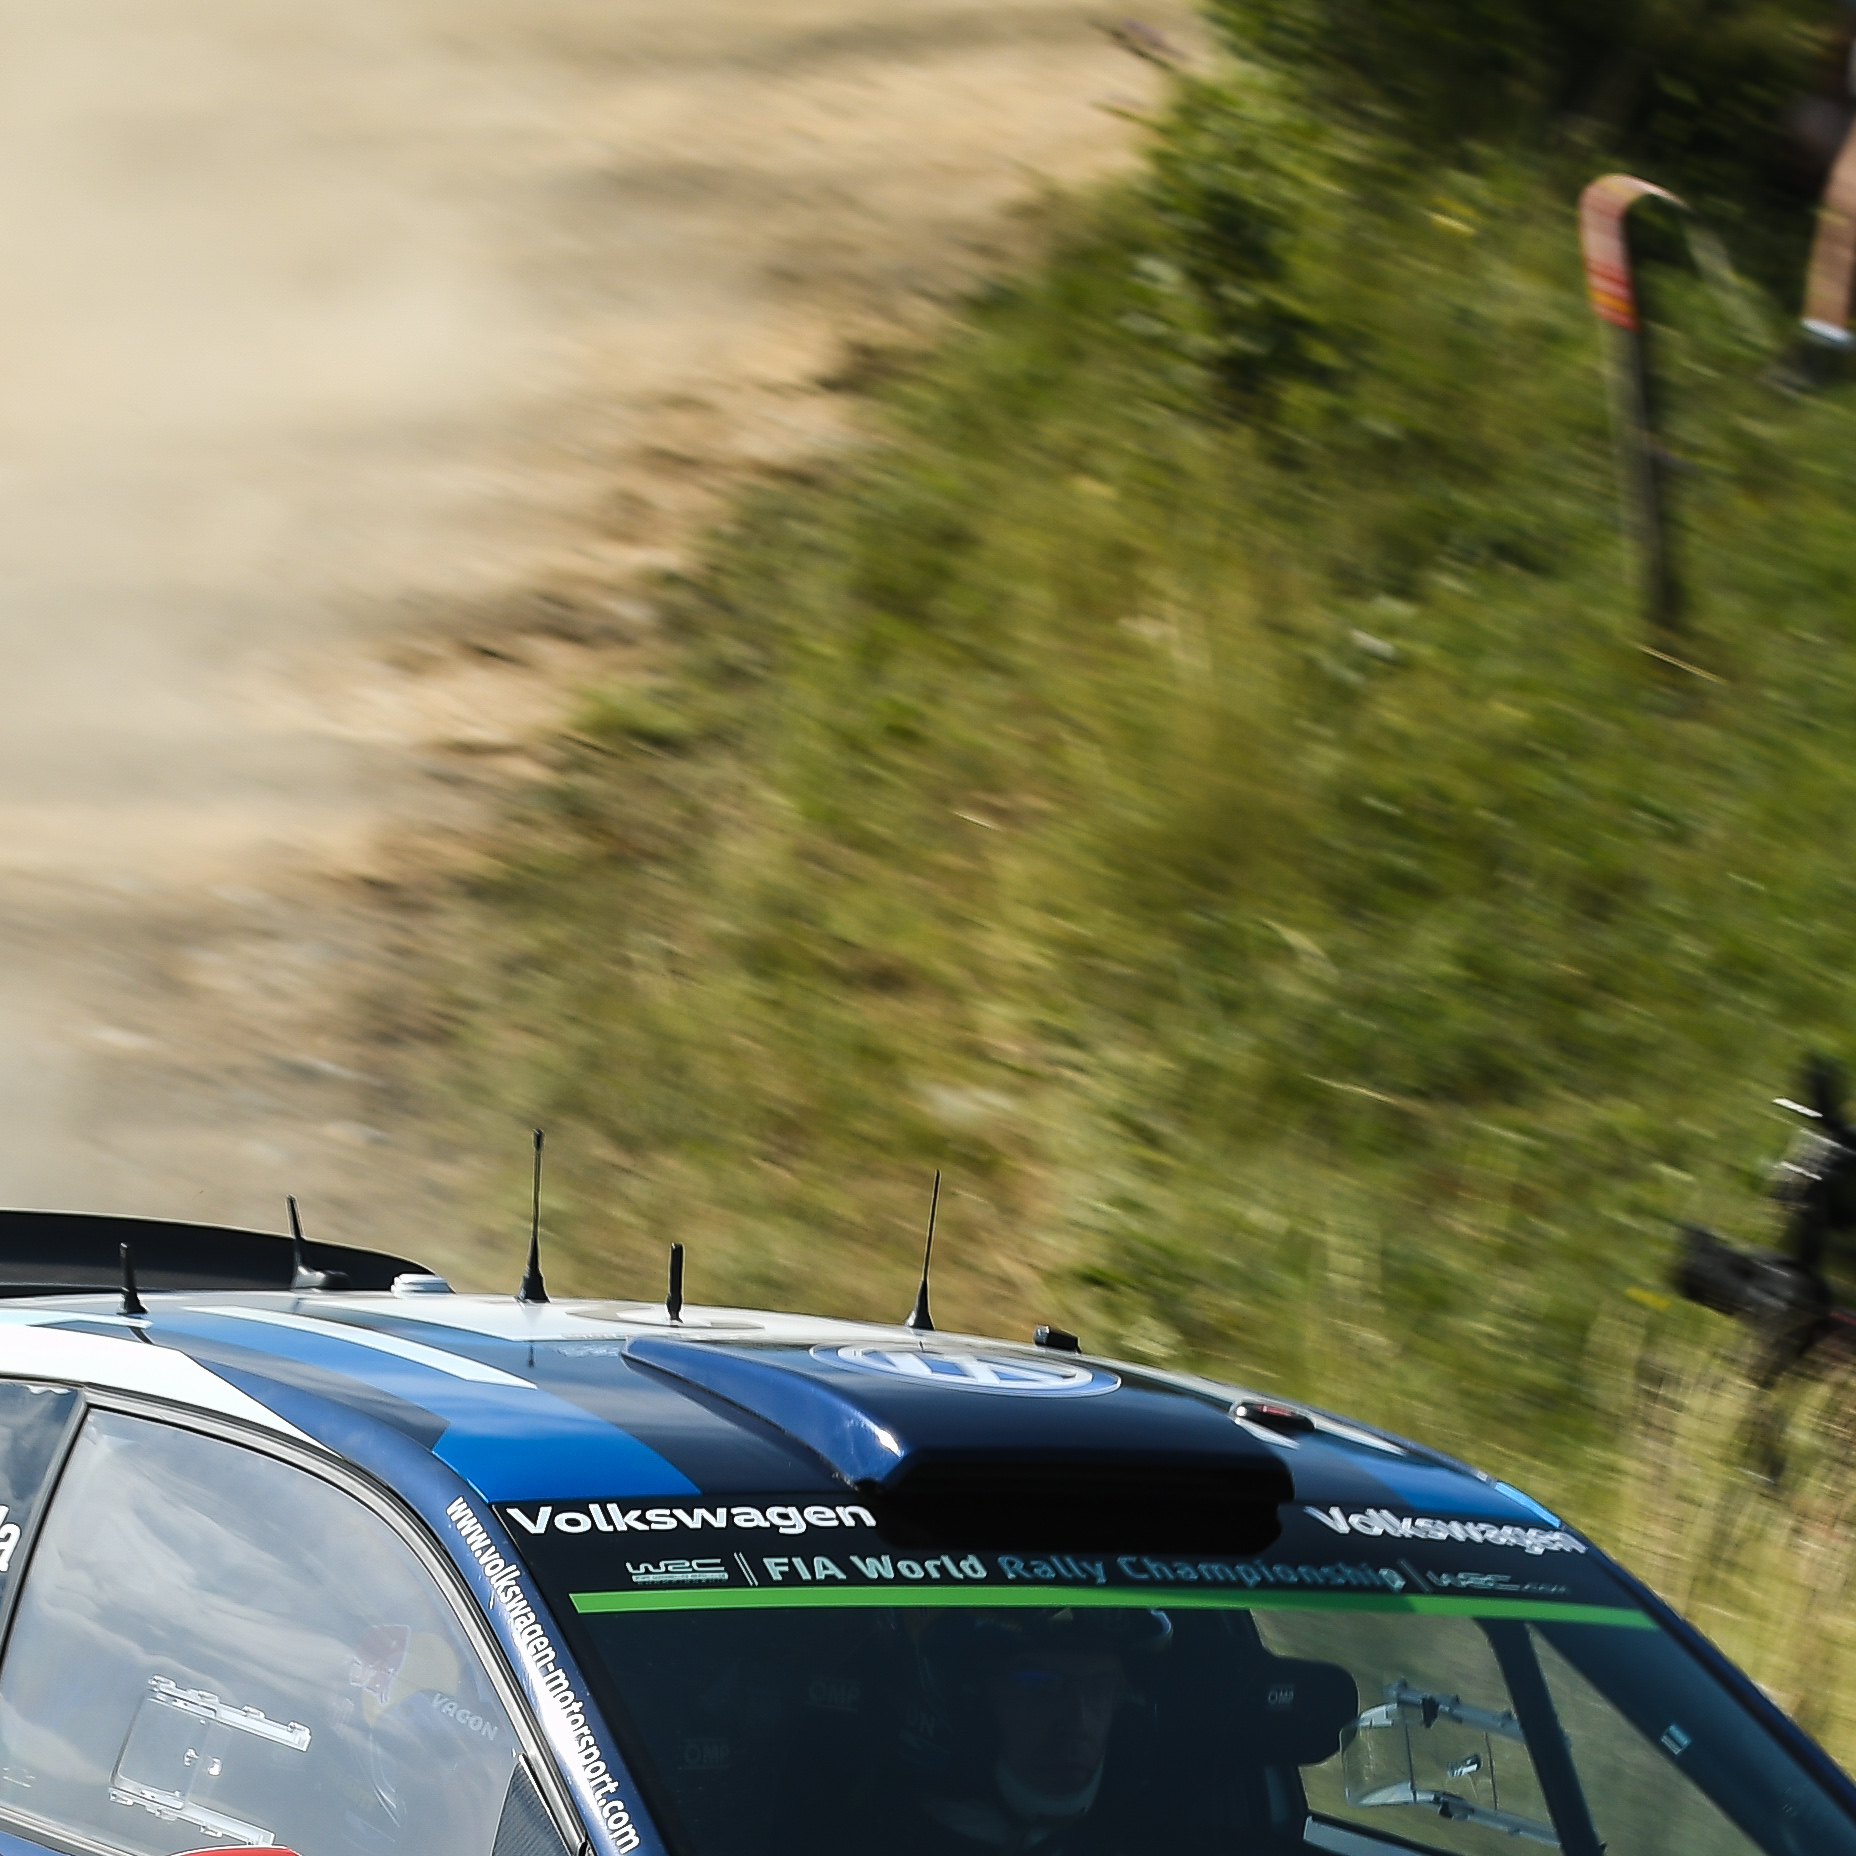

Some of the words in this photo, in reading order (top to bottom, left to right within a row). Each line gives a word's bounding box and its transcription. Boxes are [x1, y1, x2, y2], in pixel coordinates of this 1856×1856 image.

[506, 1503, 877, 1535] Volkswagen
[1305, 1506, 1588, 1555] Volkswagen
[762, 1556, 846, 1581] FIA
[850, 1554, 987, 1580] World
[997, 1555, 1105, 1584] Rally
[1117, 1556, 1406, 1592] Championship
[445, 1497, 640, 1854] www.volkswagen-motorsport.com
